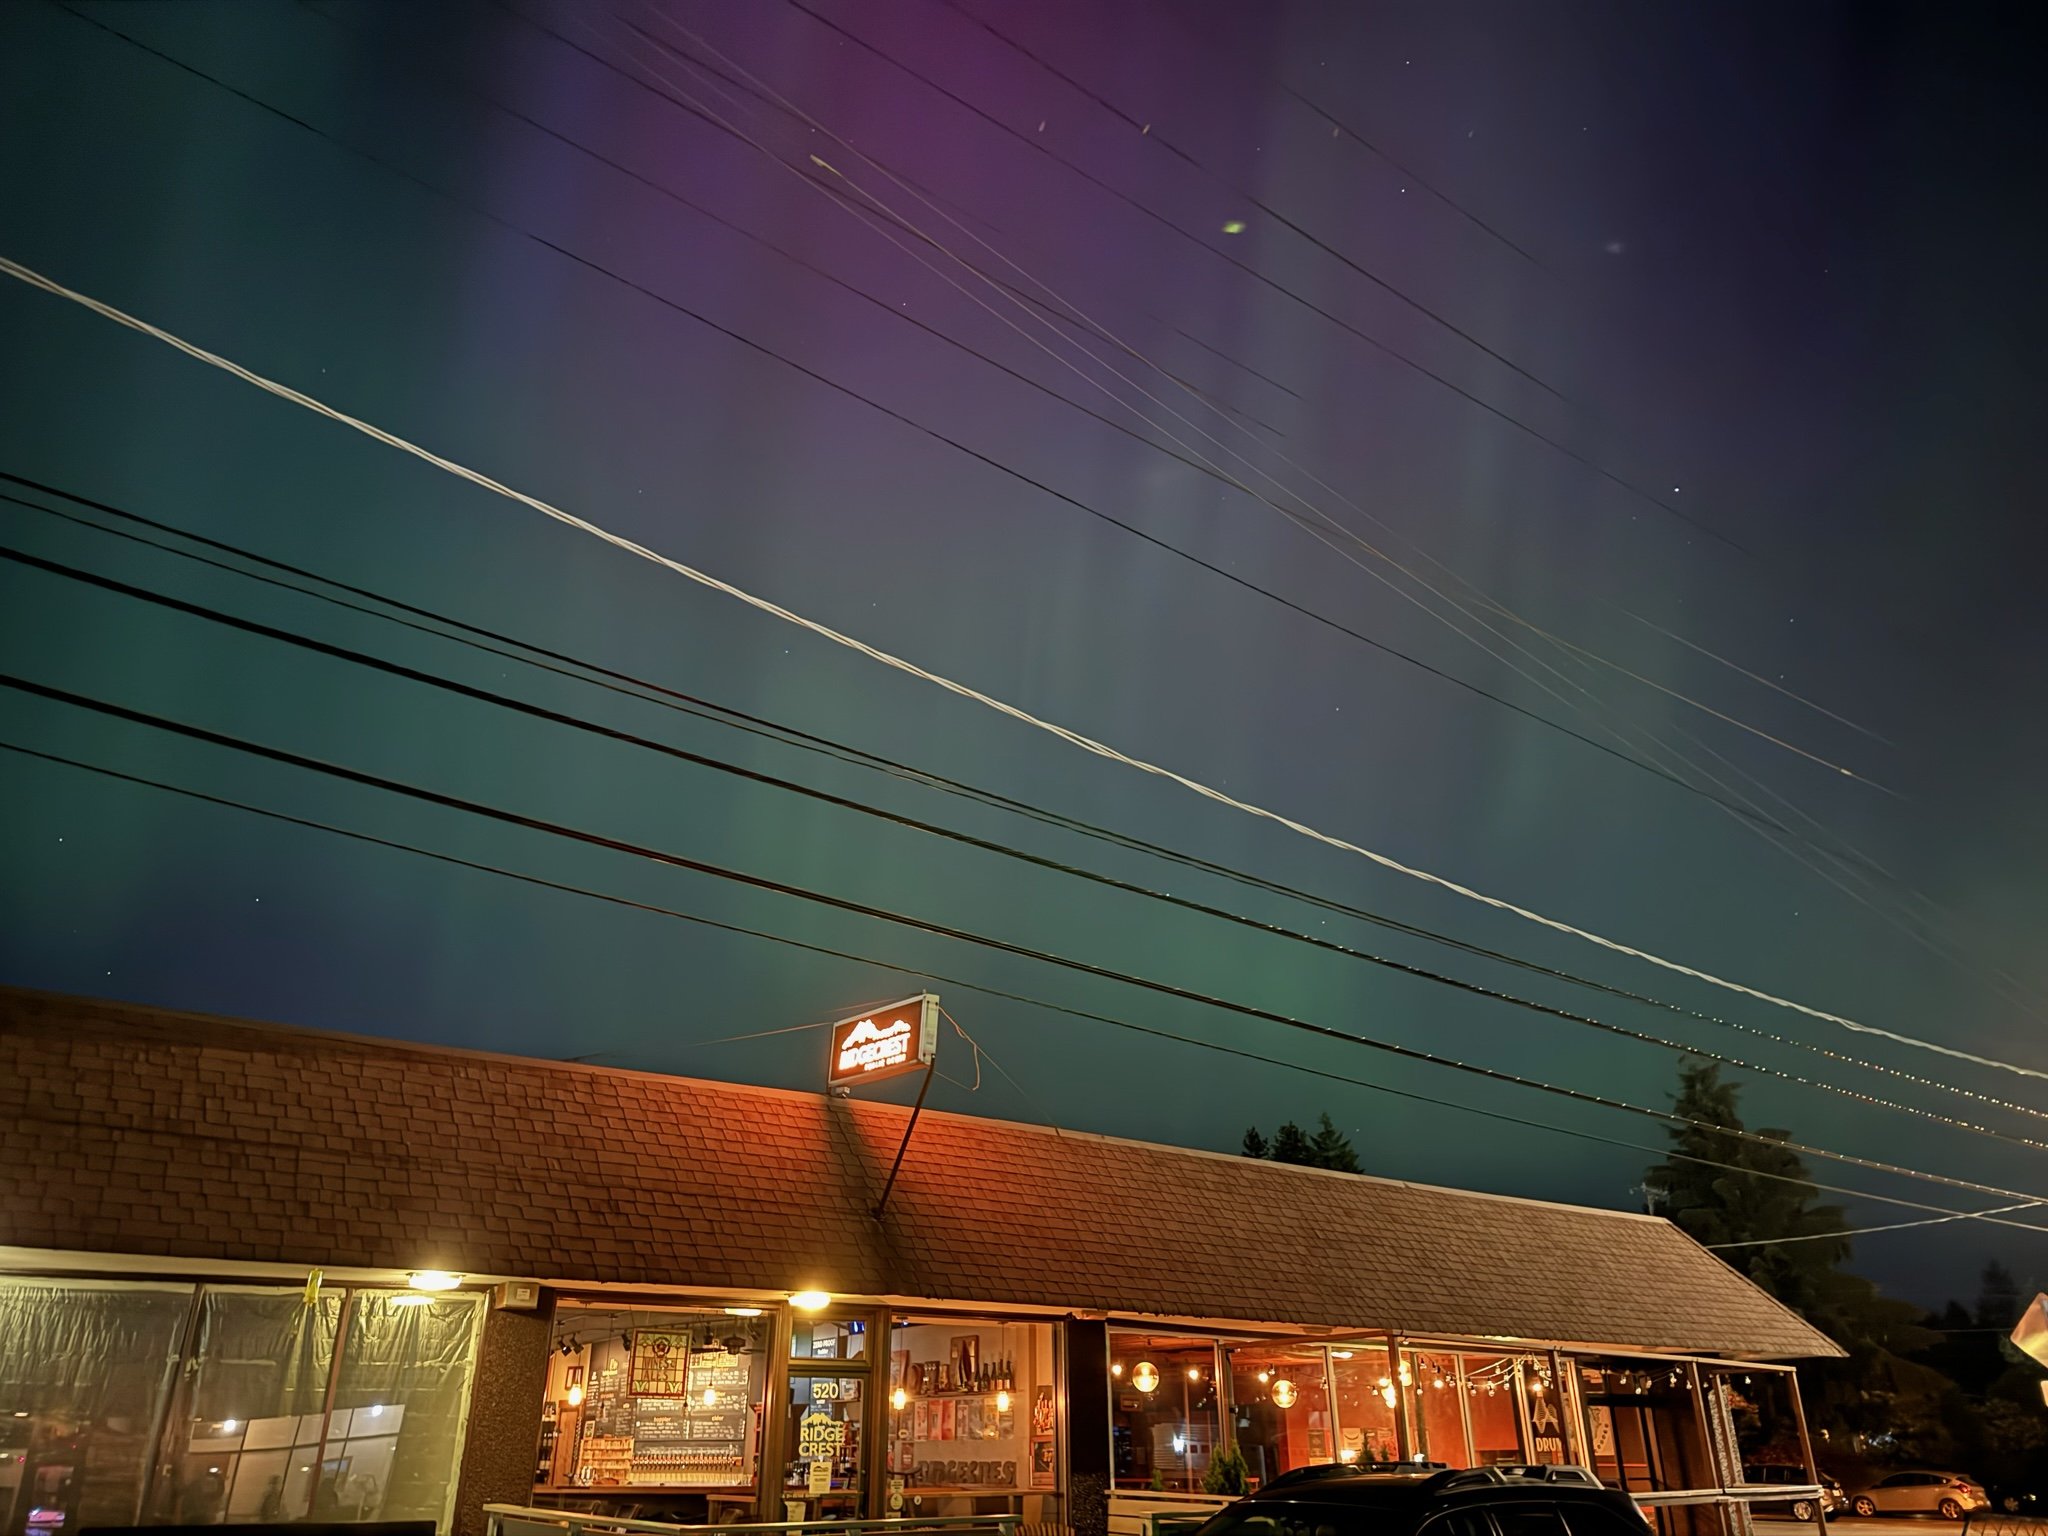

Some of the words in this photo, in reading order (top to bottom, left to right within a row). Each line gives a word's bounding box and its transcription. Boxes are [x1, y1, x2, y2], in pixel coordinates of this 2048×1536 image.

[643, 1370, 668, 1381] ALES
[813, 1382, 839, 1399] 520
[800, 1426, 844, 1442] RIDGE
[799, 1442, 843, 1457] CREST
